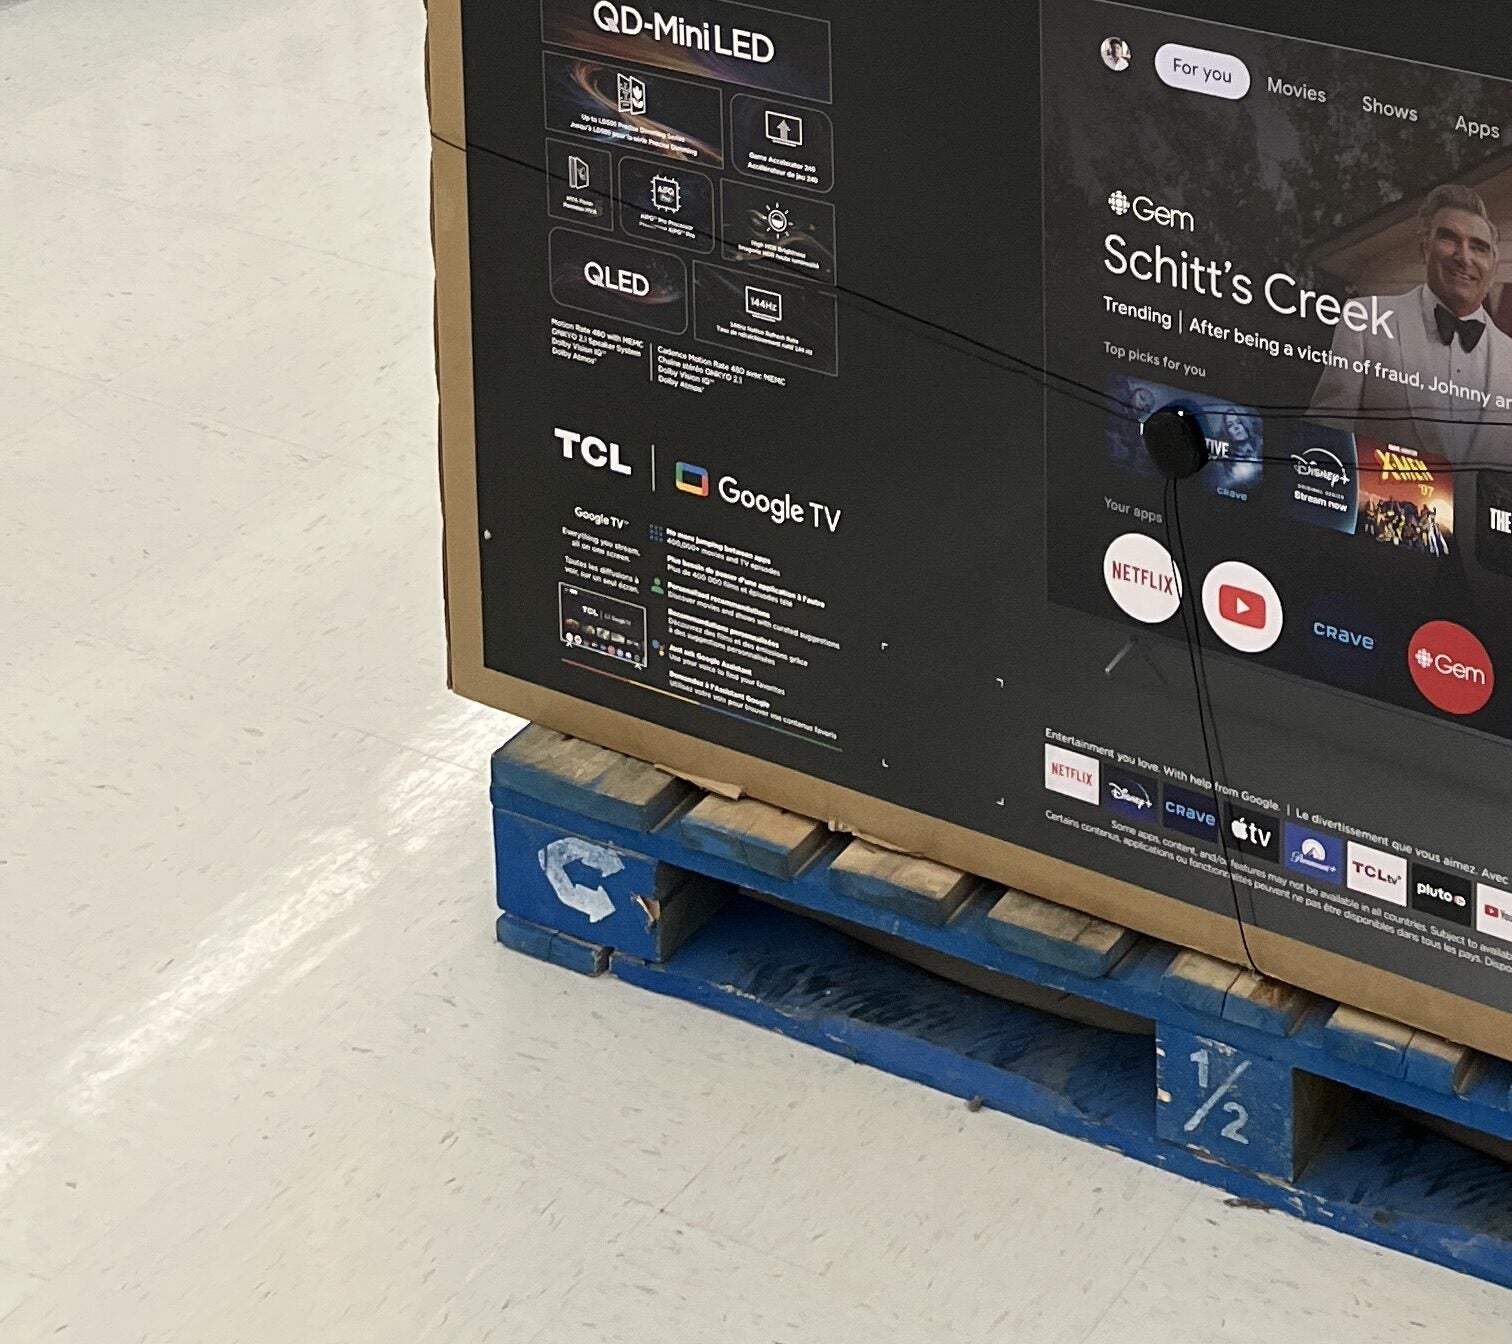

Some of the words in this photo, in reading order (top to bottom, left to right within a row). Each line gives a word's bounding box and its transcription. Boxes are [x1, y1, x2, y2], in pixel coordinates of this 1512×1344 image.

[1172, 56, 1199, 76] For
[1202, 64, 1233, 86] you
[1267, 75, 1327, 103] Movies
[1362, 95, 1419, 123] Shows
[1454, 114, 1501, 141] Apps
[1132, 195, 1196, 233] Gem
[584, 261, 650, 297] QLED
[1104, 232, 1254, 307] Schitt's
[1264, 271, 1396, 341] Creek
[1103, 295, 1173, 332] Trending
[1188, 315, 1231, 343] After
[1233, 326, 1281, 357] being
[1283, 342, 1295, 357] a
[1297, 345, 1350, 372] victim
[1352, 355, 1372, 375] of
[1374, 360, 1426, 392] fraud,
[1428, 375, 1493, 409] Johnny
[554, 427, 632, 476] TCL
[717, 475, 805, 525] Google
[808, 501, 842, 533] TV
[1489, 507, 1512, 533] THE
[1111, 559, 1175, 597] NETFLIX
[1044, 727, 1115, 760] Entertainment
[1116, 748, 1136, 765] you
[1138, 753, 1161, 774] love.
[1163, 765, 1189, 783] With
[1190, 771, 1213, 793] help
